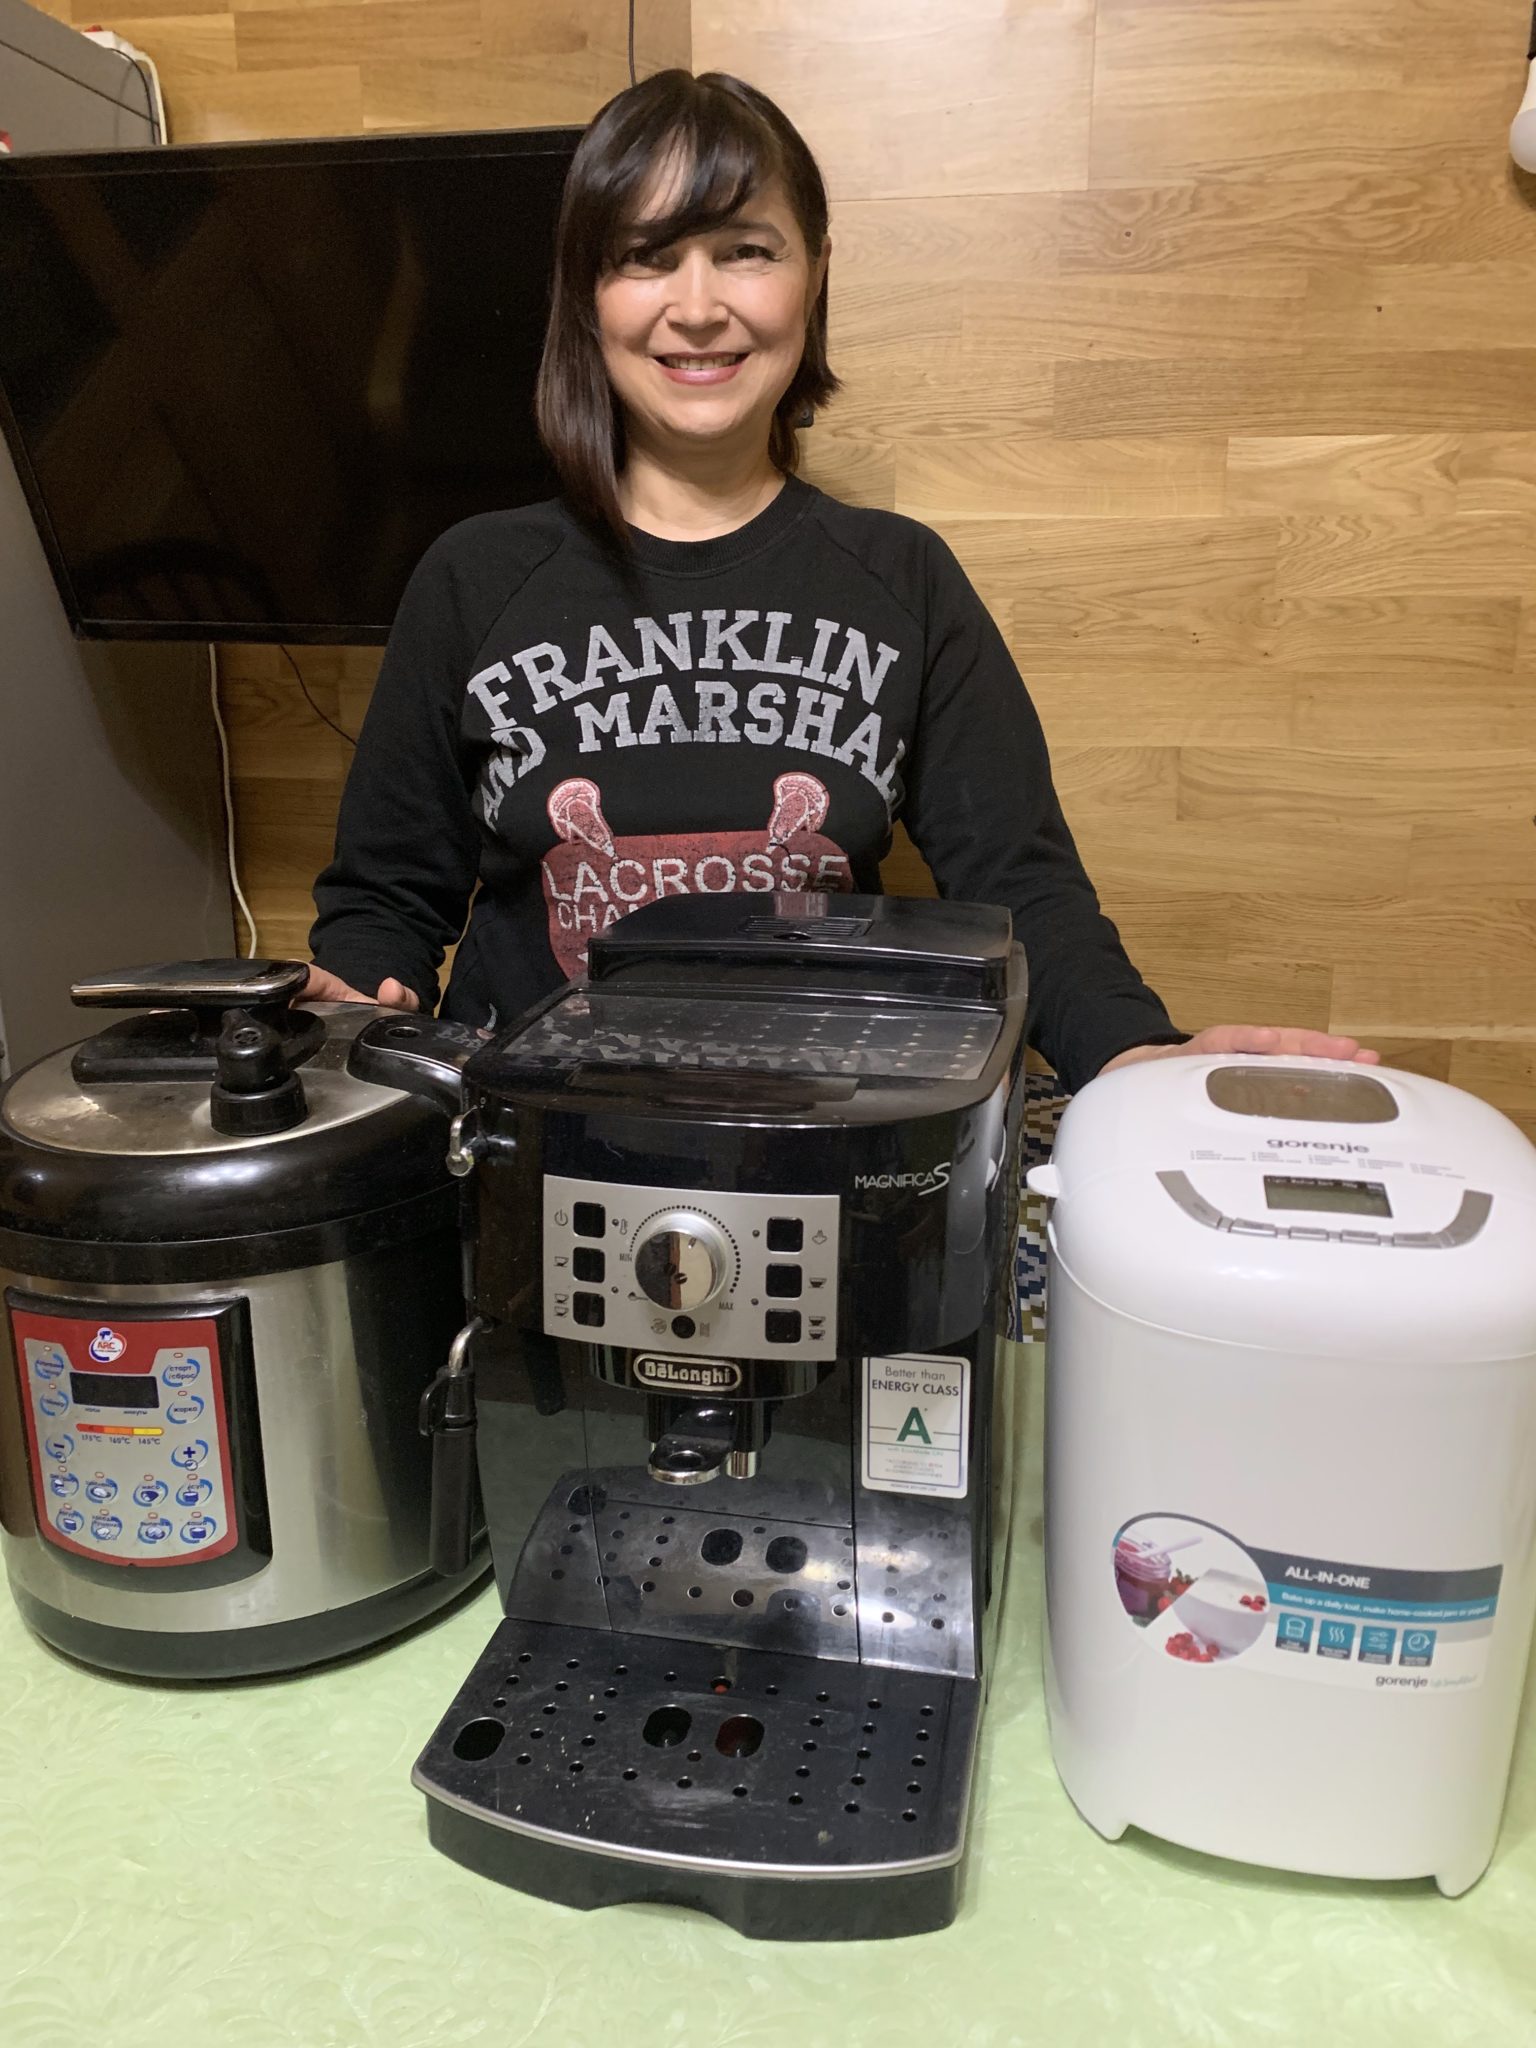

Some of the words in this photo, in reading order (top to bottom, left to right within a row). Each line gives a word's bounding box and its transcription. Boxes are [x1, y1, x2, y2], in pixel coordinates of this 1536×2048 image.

[467, 609, 900, 731] FRANKLIN
[557, 902, 640, 933] CHA
[1266, 1138, 1371, 1154] gorenje
[718, 1302, 734, 1311] MAX
[885, 1366, 917, 1379] Better
[921, 1369, 946, 1381] than
[872, 1379, 919, 1393] ENERGY
[922, 1384, 960, 1397] CLASS
[1284, 1565, 1372, 1590] ALL-IN-ONE
[1375, 1674, 1429, 1689] gorenje
